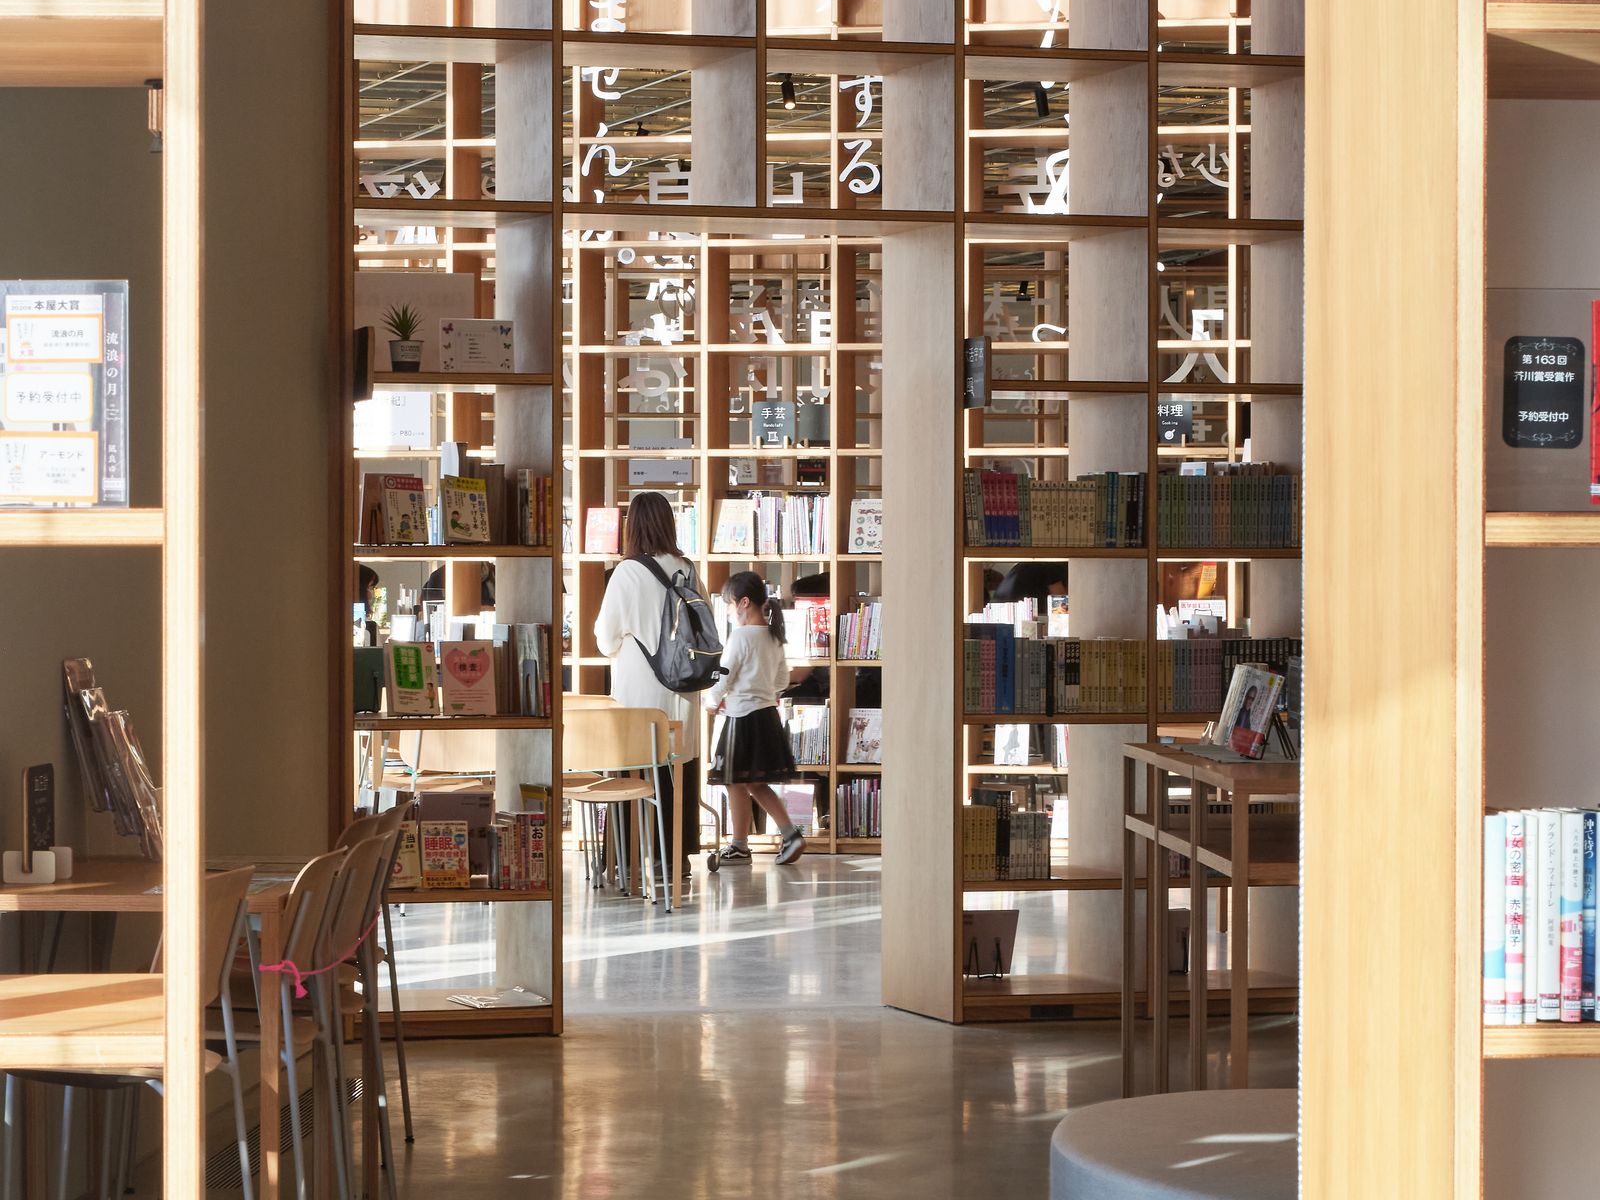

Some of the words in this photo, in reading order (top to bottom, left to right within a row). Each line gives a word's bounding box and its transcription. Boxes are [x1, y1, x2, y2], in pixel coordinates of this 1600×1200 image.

[34, 300, 81, 311] 本屋大賞
[106, 332, 119, 396] 流浪の月
[1514, 371, 1575, 383] 芥川賞受賞作
[15, 391, 82, 404] 予約受付中
[761, 407, 786, 420] 手芸
[1157, 404, 1184, 417] 料理
[1518, 411, 1569, 422] 予約受付中
[108, 444, 118, 478] 凪良ゆ
[1509, 824, 1521, 886] 乙女の密告
